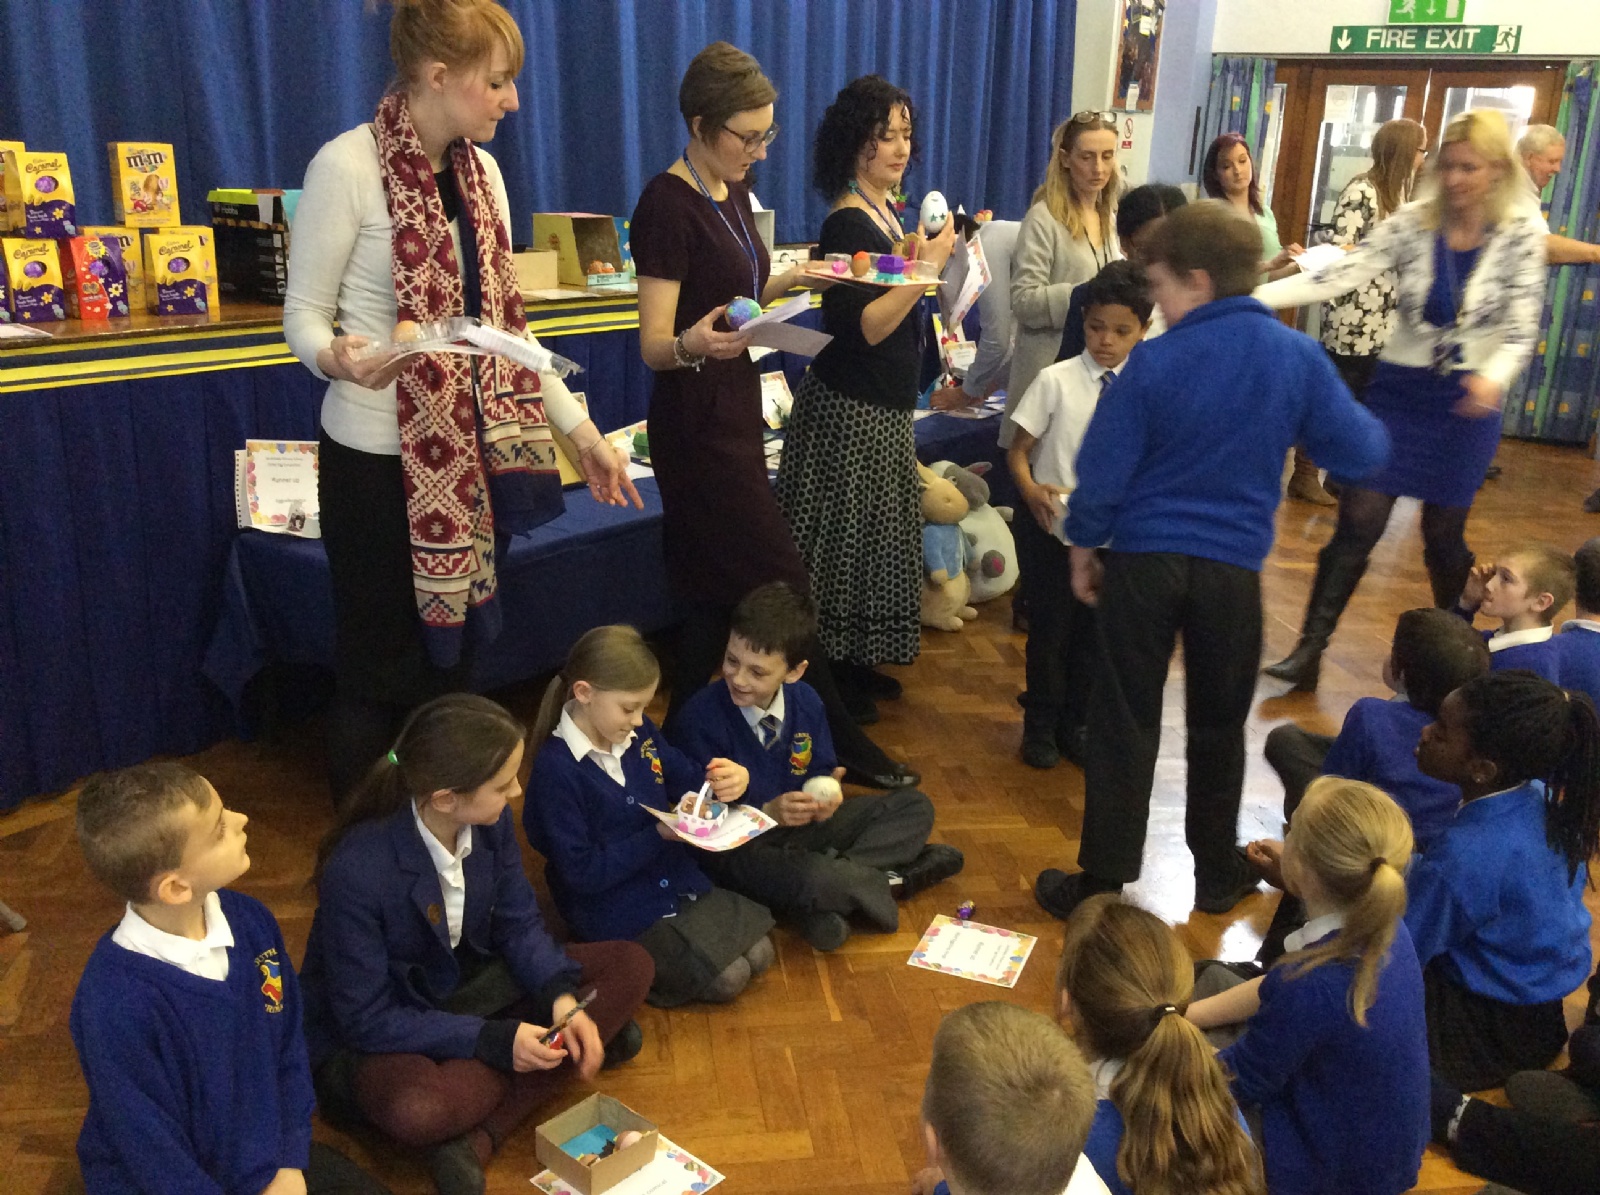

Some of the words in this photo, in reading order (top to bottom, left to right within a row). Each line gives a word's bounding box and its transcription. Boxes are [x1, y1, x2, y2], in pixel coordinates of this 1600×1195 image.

[1366, 28, 1416, 49] FIRE
[1425, 28, 1481, 49] EXIT
[25, 158, 62, 175] Caramel
[13, 243, 50, 260] Caramel
[158, 240, 194, 256] Caramel
